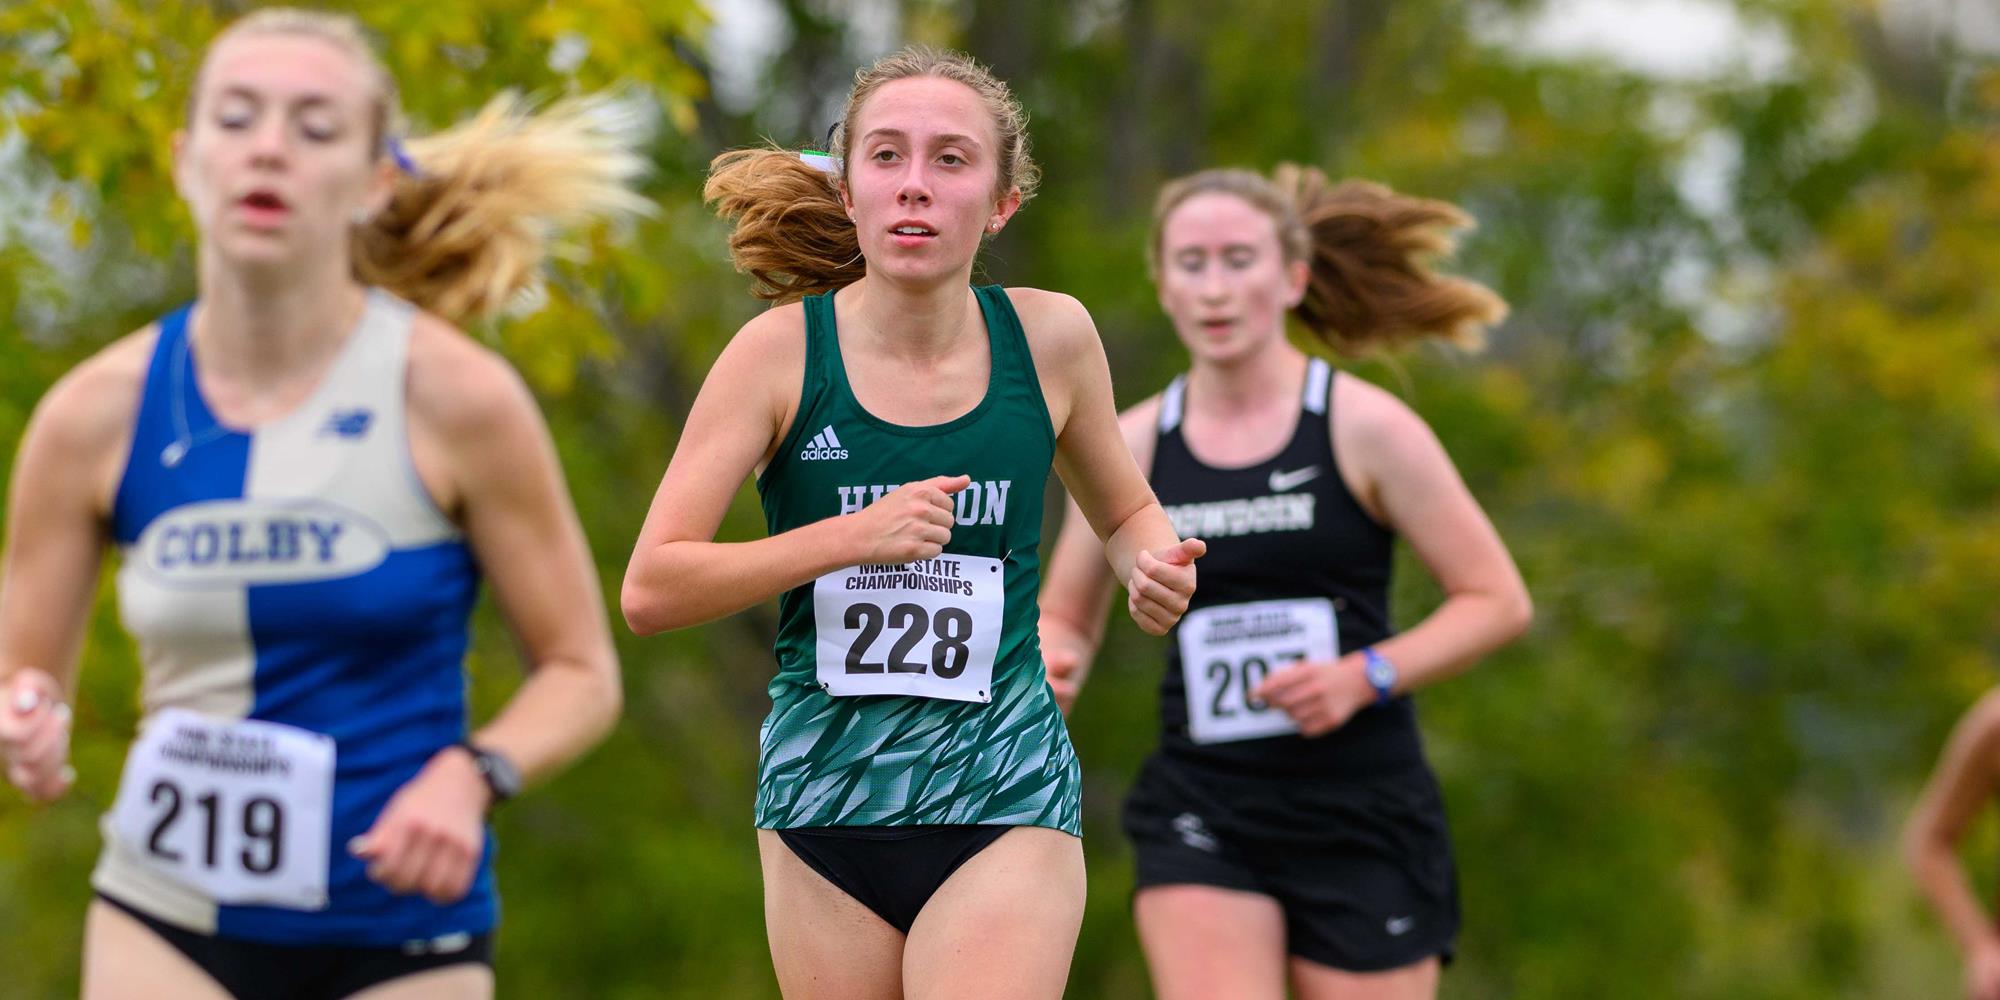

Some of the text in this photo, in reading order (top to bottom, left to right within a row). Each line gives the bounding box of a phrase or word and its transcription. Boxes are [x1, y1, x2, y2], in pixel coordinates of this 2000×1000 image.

[801, 448, 848, 461] adidas
[838, 480, 1011, 526] HON
[155, 518, 341, 568] COLBY
[845, 572, 974, 597] CHAMPIONSHIPS
[914, 559, 961, 578] STATE
[843, 602, 973, 680] 228
[1206, 652, 1306, 718] 20
[149, 780, 283, 874] 219
